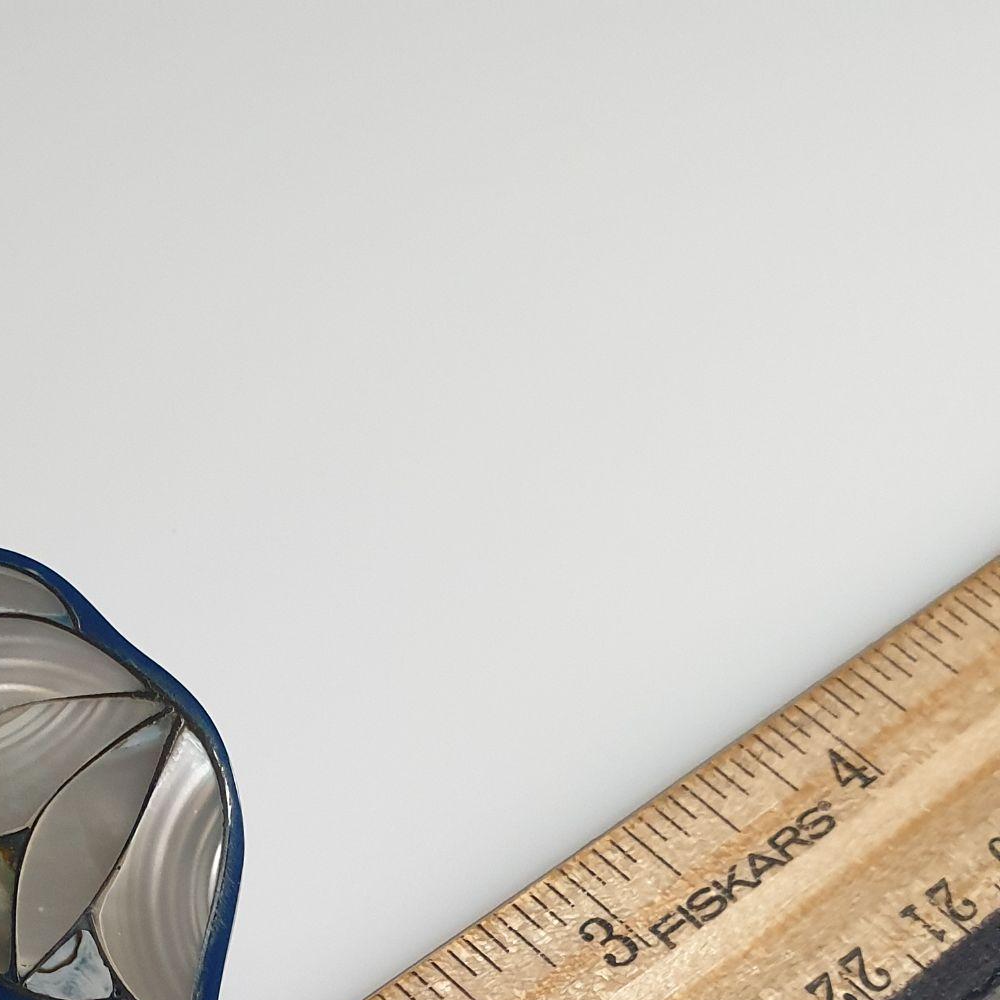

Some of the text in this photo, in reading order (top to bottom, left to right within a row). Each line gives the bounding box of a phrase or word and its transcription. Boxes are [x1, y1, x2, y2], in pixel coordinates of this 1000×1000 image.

[829, 749, 878, 789] 4
[649, 804, 836, 948] FISKARS
[901, 878, 977, 941] 21
[579, 917, 637, 966] 3
